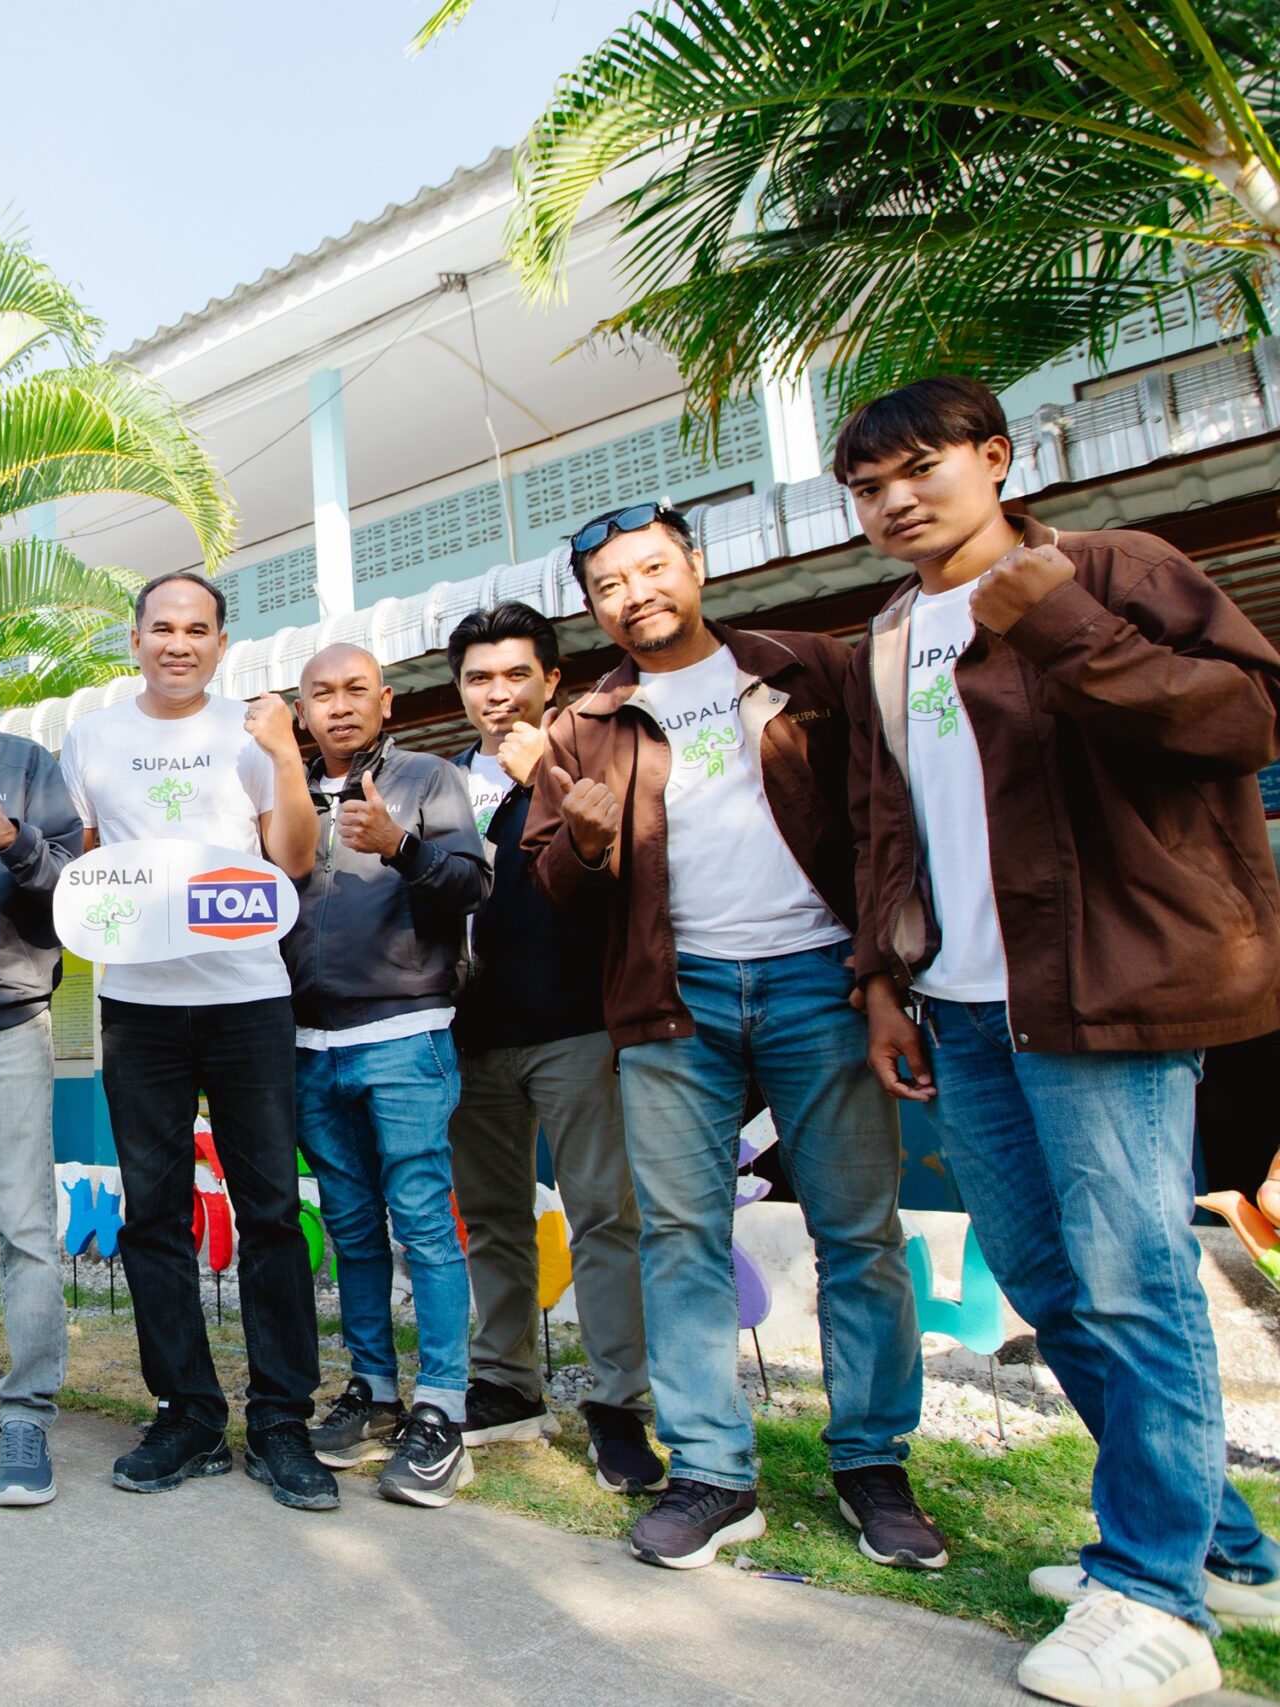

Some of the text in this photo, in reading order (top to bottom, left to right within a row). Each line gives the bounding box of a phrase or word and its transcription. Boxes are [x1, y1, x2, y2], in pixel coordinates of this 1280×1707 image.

[132, 755, 210, 771] SUPALAI
[69, 868, 153, 886] SUPALAI
[191, 888, 274, 919] TOA
